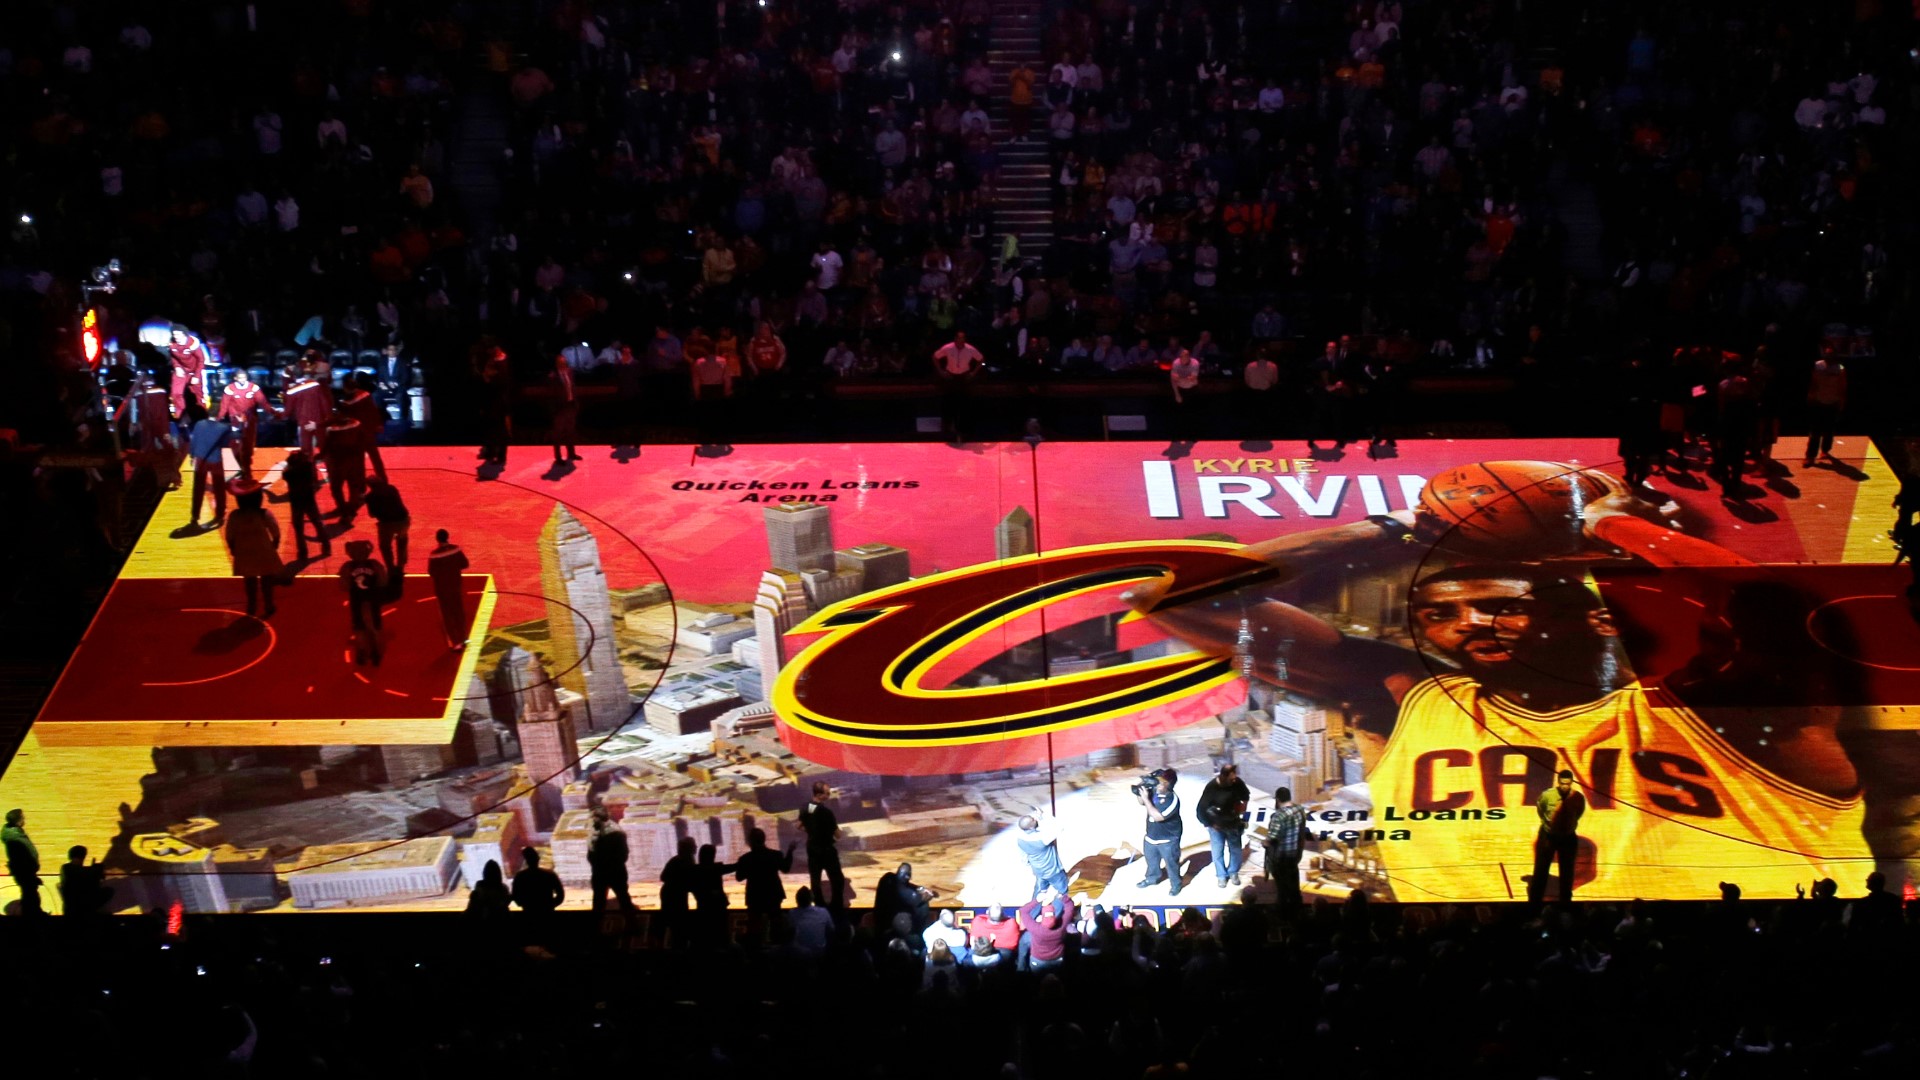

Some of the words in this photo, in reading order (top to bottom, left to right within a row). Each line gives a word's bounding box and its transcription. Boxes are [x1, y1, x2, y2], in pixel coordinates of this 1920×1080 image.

[1193, 457, 1319, 474] KYRIE
[671, 479, 809, 491] Quicken
[820, 478, 920, 490] Loans
[738, 492, 839, 503] Arena
[1411, 744, 1725, 818] CAVS
[1384, 806, 1508, 822] Loans
